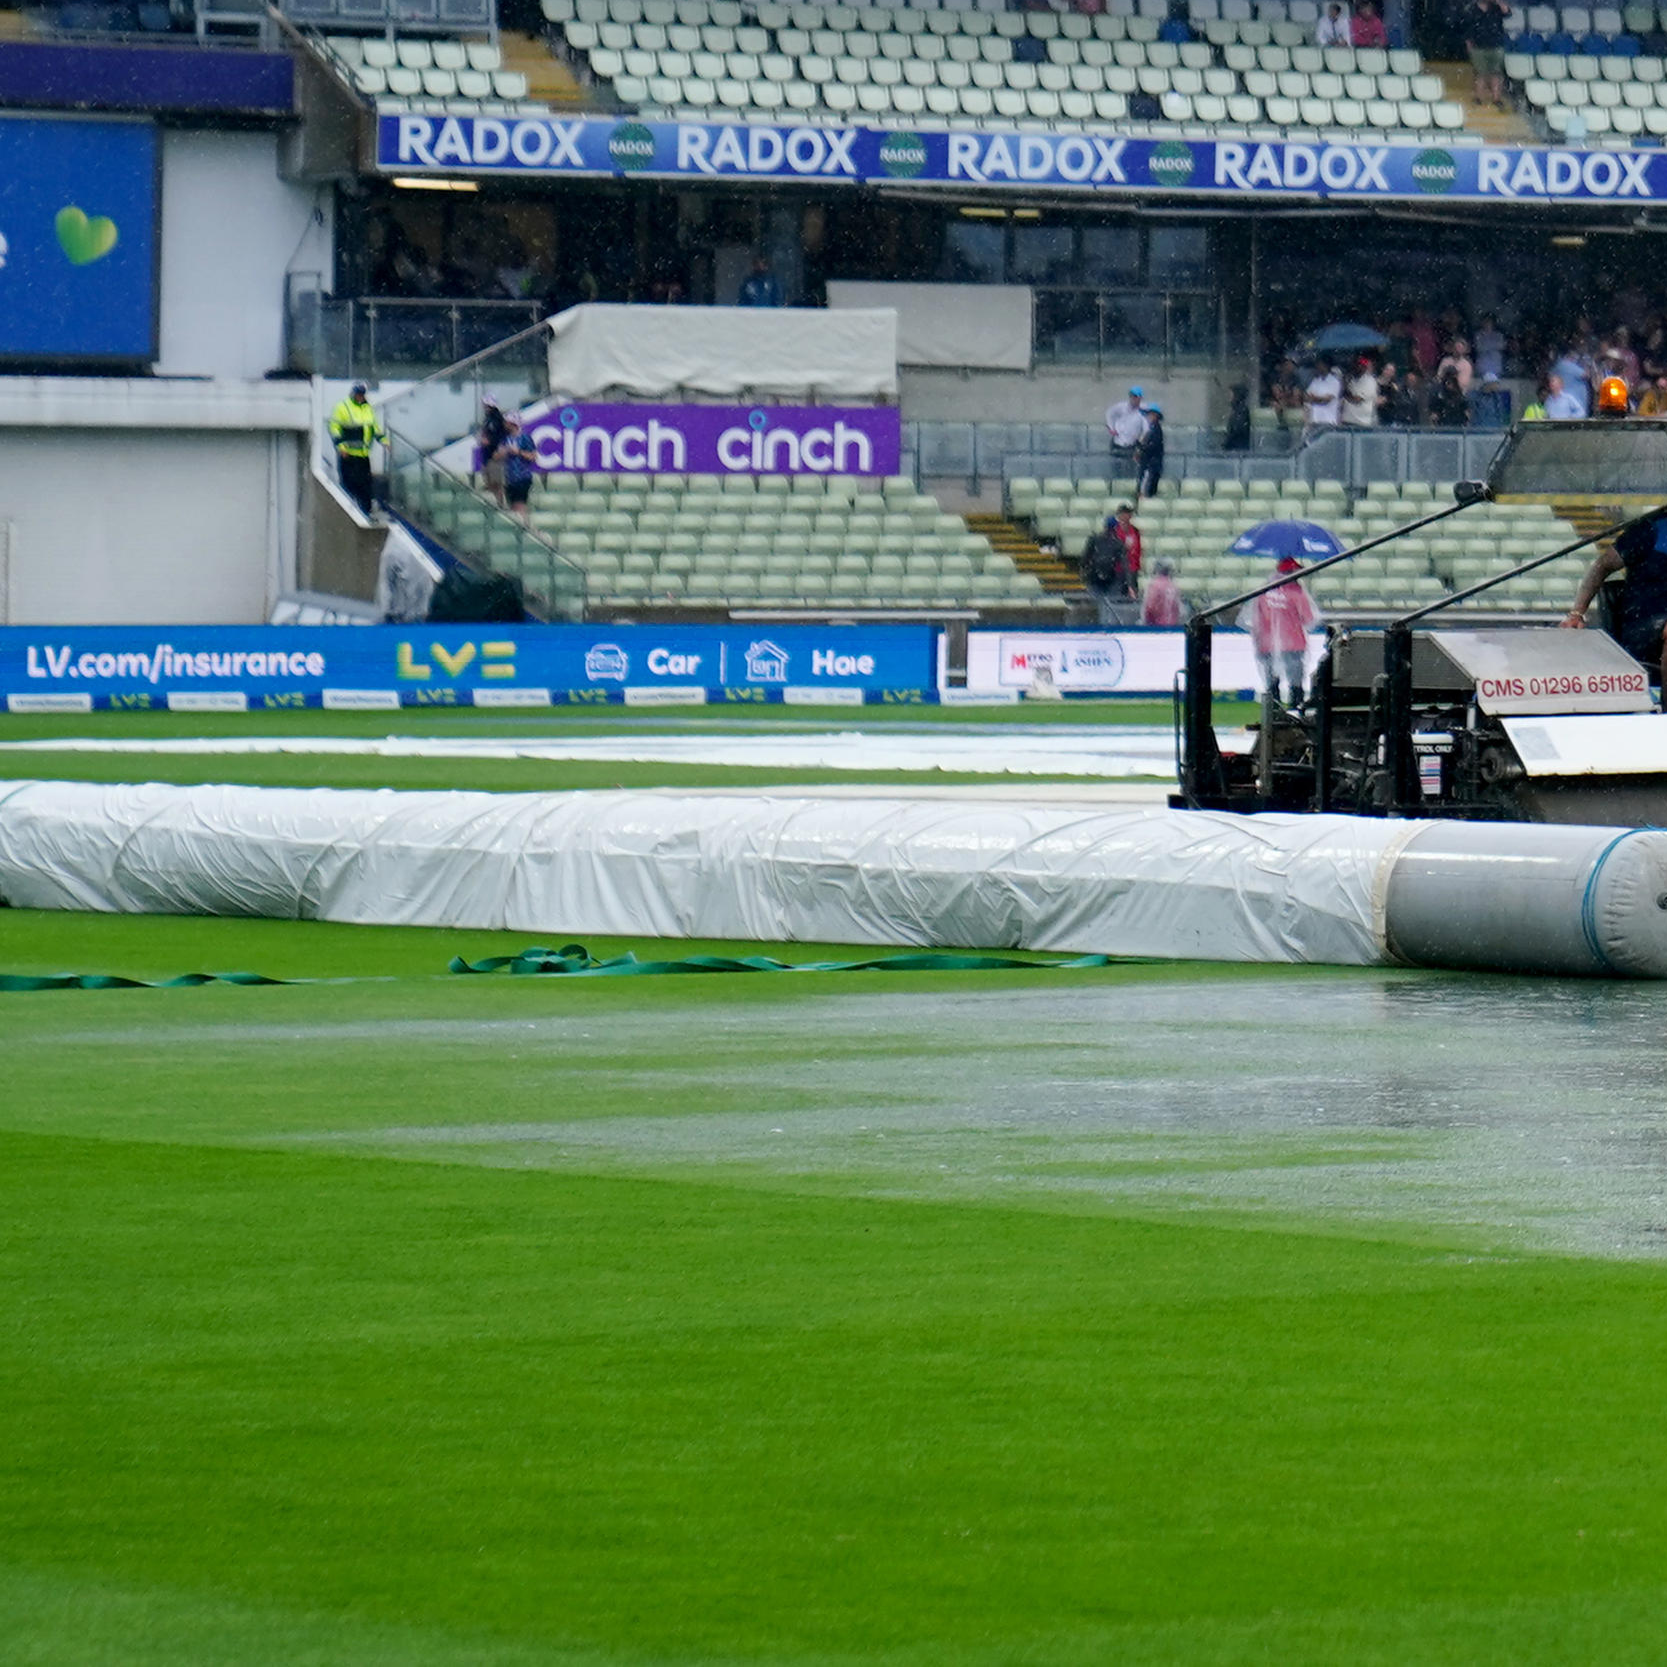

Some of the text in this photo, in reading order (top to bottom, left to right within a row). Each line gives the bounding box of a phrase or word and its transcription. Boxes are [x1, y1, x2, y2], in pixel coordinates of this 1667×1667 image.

[399, 117, 584, 168] RADOX
[609, 136, 653, 157] RADOX
[677, 126, 856, 173] RADOX
[880, 146, 926, 165] RADOX
[948, 135, 1126, 183] RADOX
[1149, 155, 1193, 174] RADOX
[1215, 144, 1389, 190] RADOX
[1412, 163, 1456, 181] RADOX
[1478, 150, 1652, 196] RADOX
[532, 407, 872, 472] cinch cinch
[27, 643, 325, 684] LV.com/insurance
[647, 648, 700, 675] Car
[1482, 674, 1645, 697] CMS 01296 651182
